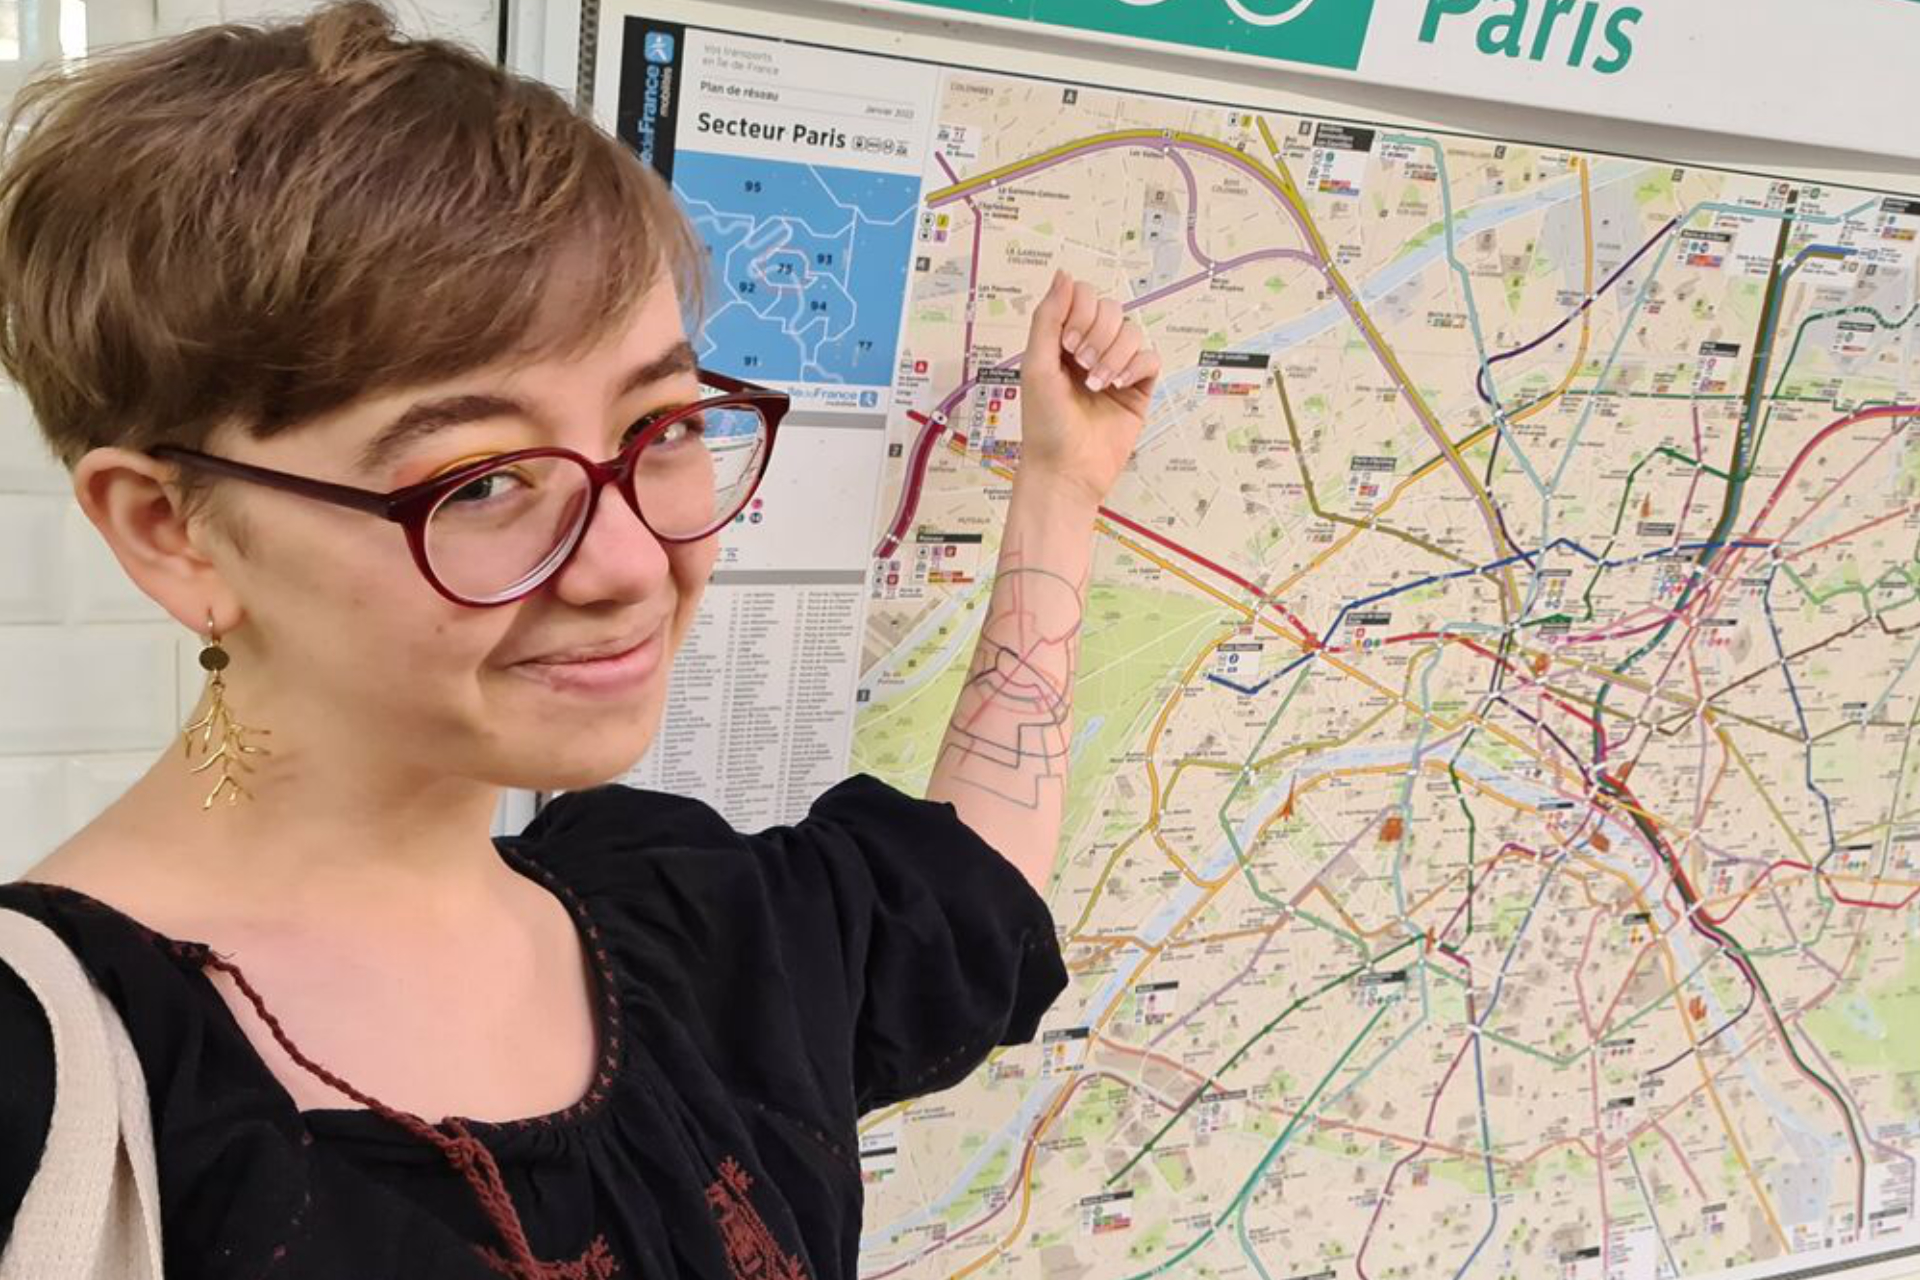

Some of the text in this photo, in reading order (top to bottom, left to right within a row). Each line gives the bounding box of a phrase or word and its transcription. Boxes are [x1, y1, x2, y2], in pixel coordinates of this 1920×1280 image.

[700, 80, 779, 101] Plan de réseau
[697, 112, 847, 150] Secteur Paris
[744, 181, 762, 193] 95
[776, 262, 793, 274] 75
